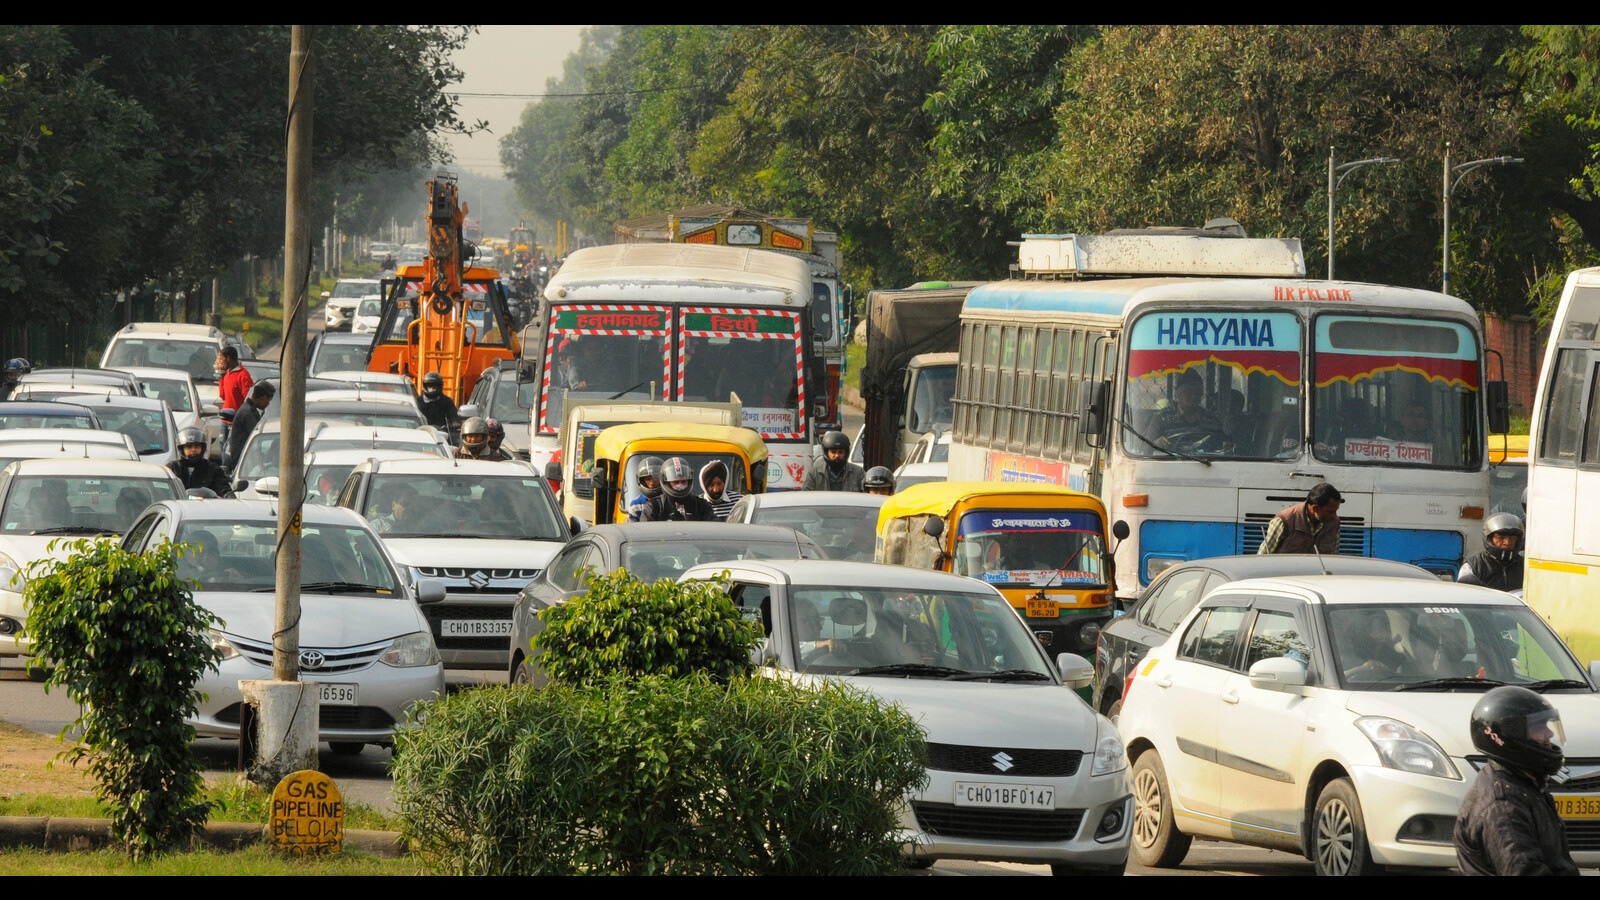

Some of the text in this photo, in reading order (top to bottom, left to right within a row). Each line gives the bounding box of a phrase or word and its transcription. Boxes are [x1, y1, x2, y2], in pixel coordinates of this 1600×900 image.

[1157, 317, 1274, 347] HARYANA
[450, 623, 513, 633] CH01BS3357
[287, 780, 328, 799] GAS
[967, 787, 1053, 805] CH01BF0147
[273, 800, 342, 818] PIPELINE
[1575, 801, 1600, 814] 3363
[274, 818, 338, 837] BELOW
